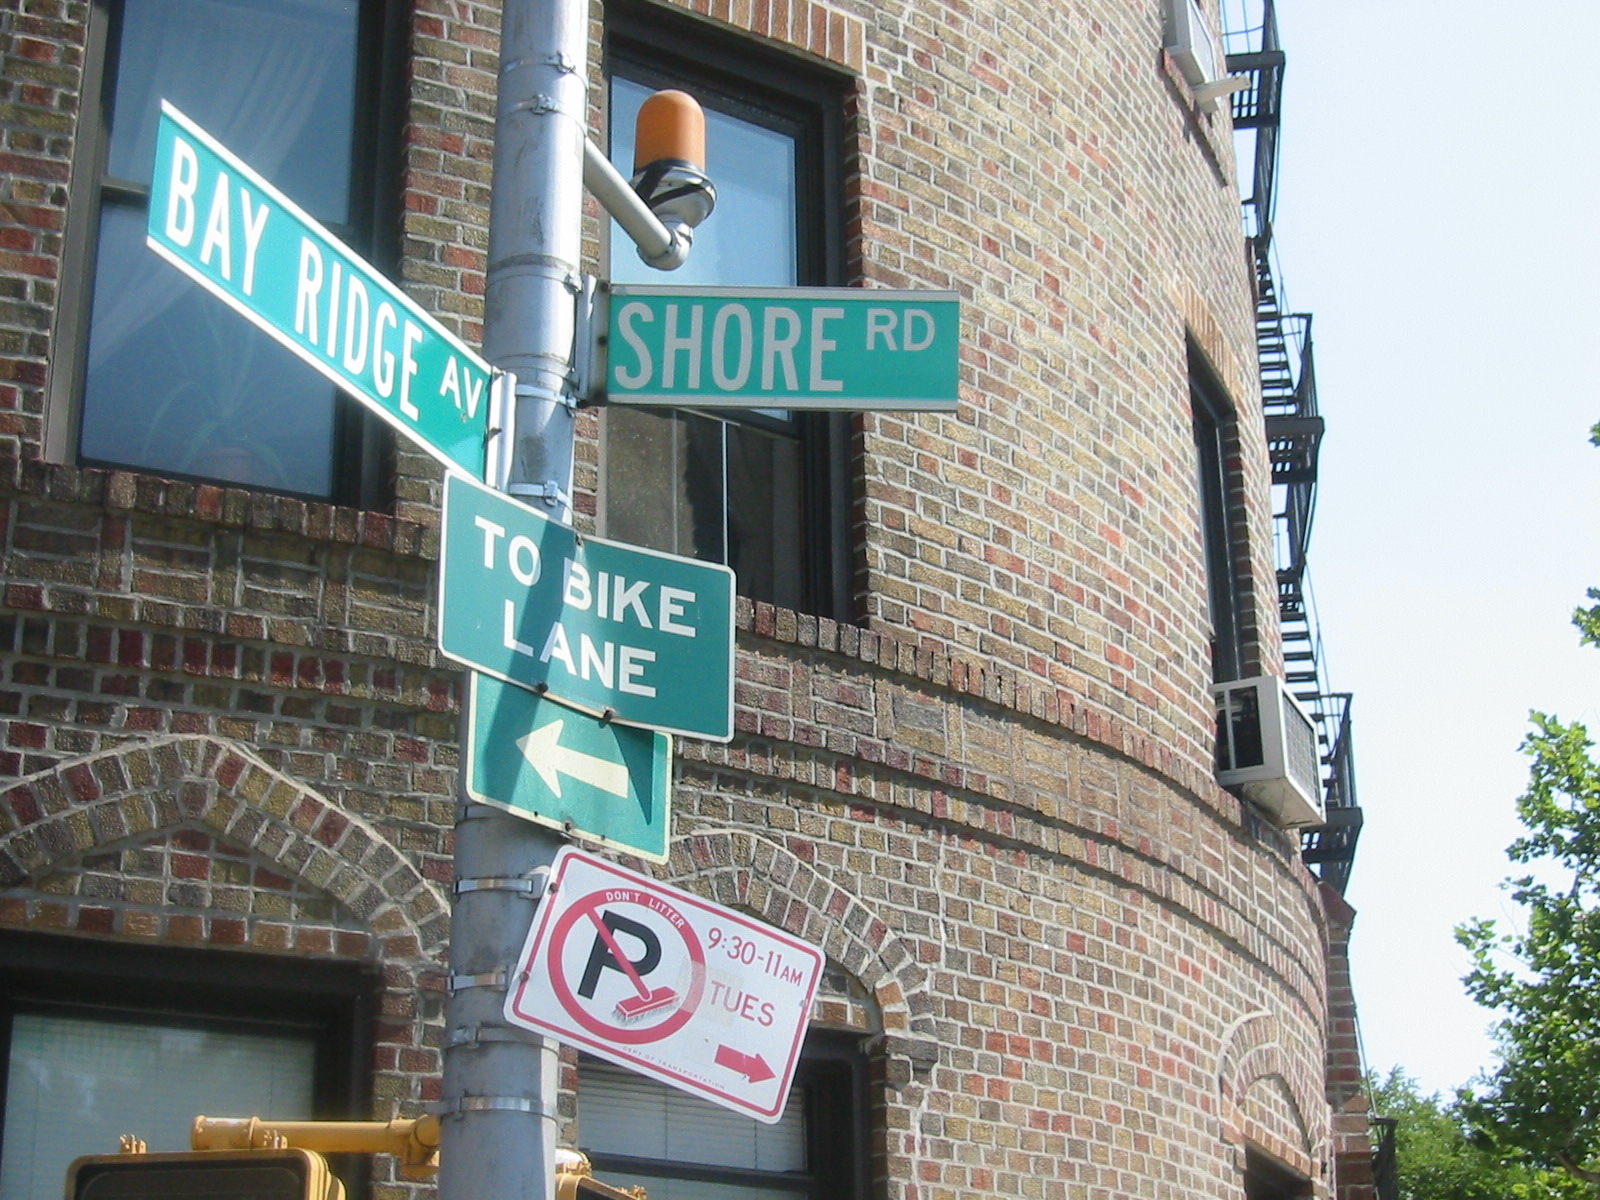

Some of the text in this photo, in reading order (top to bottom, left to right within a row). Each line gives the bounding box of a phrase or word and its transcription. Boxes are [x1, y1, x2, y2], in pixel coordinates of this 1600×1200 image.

[166, 136, 483, 421] BAY RIDGE AV
[614, 302, 936, 391] SHORE RD
[475, 515, 696, 637] TO BIKE
[503, 600, 656, 698] LANE
[605, 890, 685, 929] DON'T LITTER
[710, 980, 775, 1027] TUES
[658, 1060, 726, 1090] TRANSPORTATION
